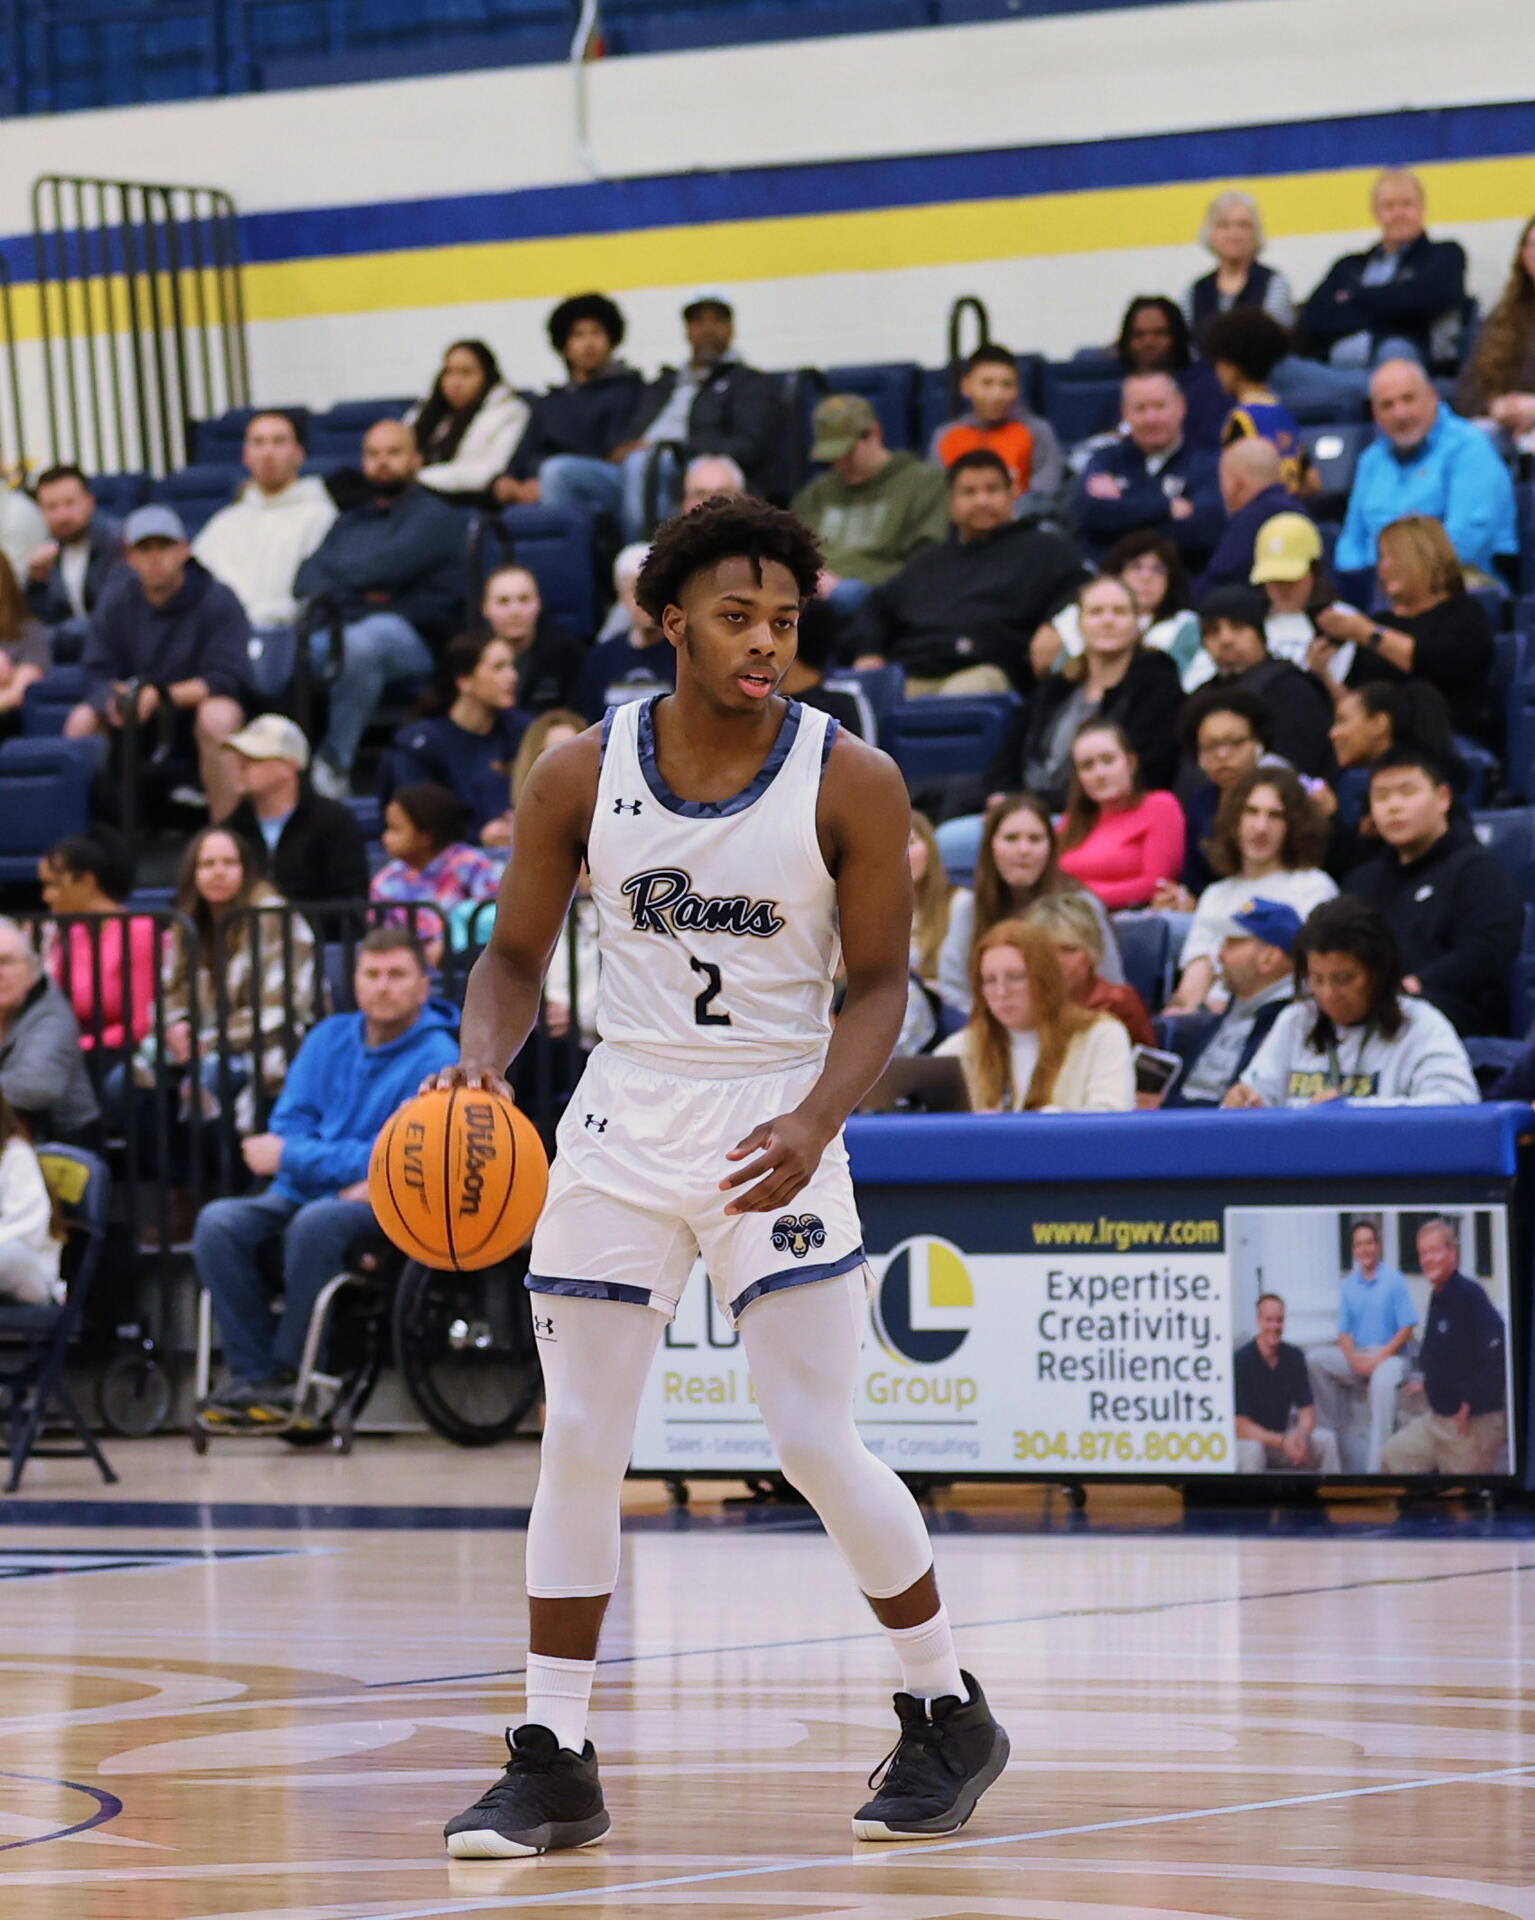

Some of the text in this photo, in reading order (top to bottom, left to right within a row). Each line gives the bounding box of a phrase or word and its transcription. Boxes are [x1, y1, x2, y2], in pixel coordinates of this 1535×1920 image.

[620, 868, 786, 941] Rams
[690, 955, 732, 1026] 2
[459, 1103, 497, 1220] Wilson
[1032, 1218, 1219, 1250] www.lrgwv.com
[1046, 1267, 1221, 1307] Expertise.
[1037, 1308, 1222, 1348] Creativity.
[1037, 1348, 1223, 1382] Resilience.
[664, 1371, 736, 1405] Real
[867, 1372, 976, 1411] Group
[1090, 1389, 1224, 1422] Results.
[1013, 1431, 1226, 1461] 304.876.8000
